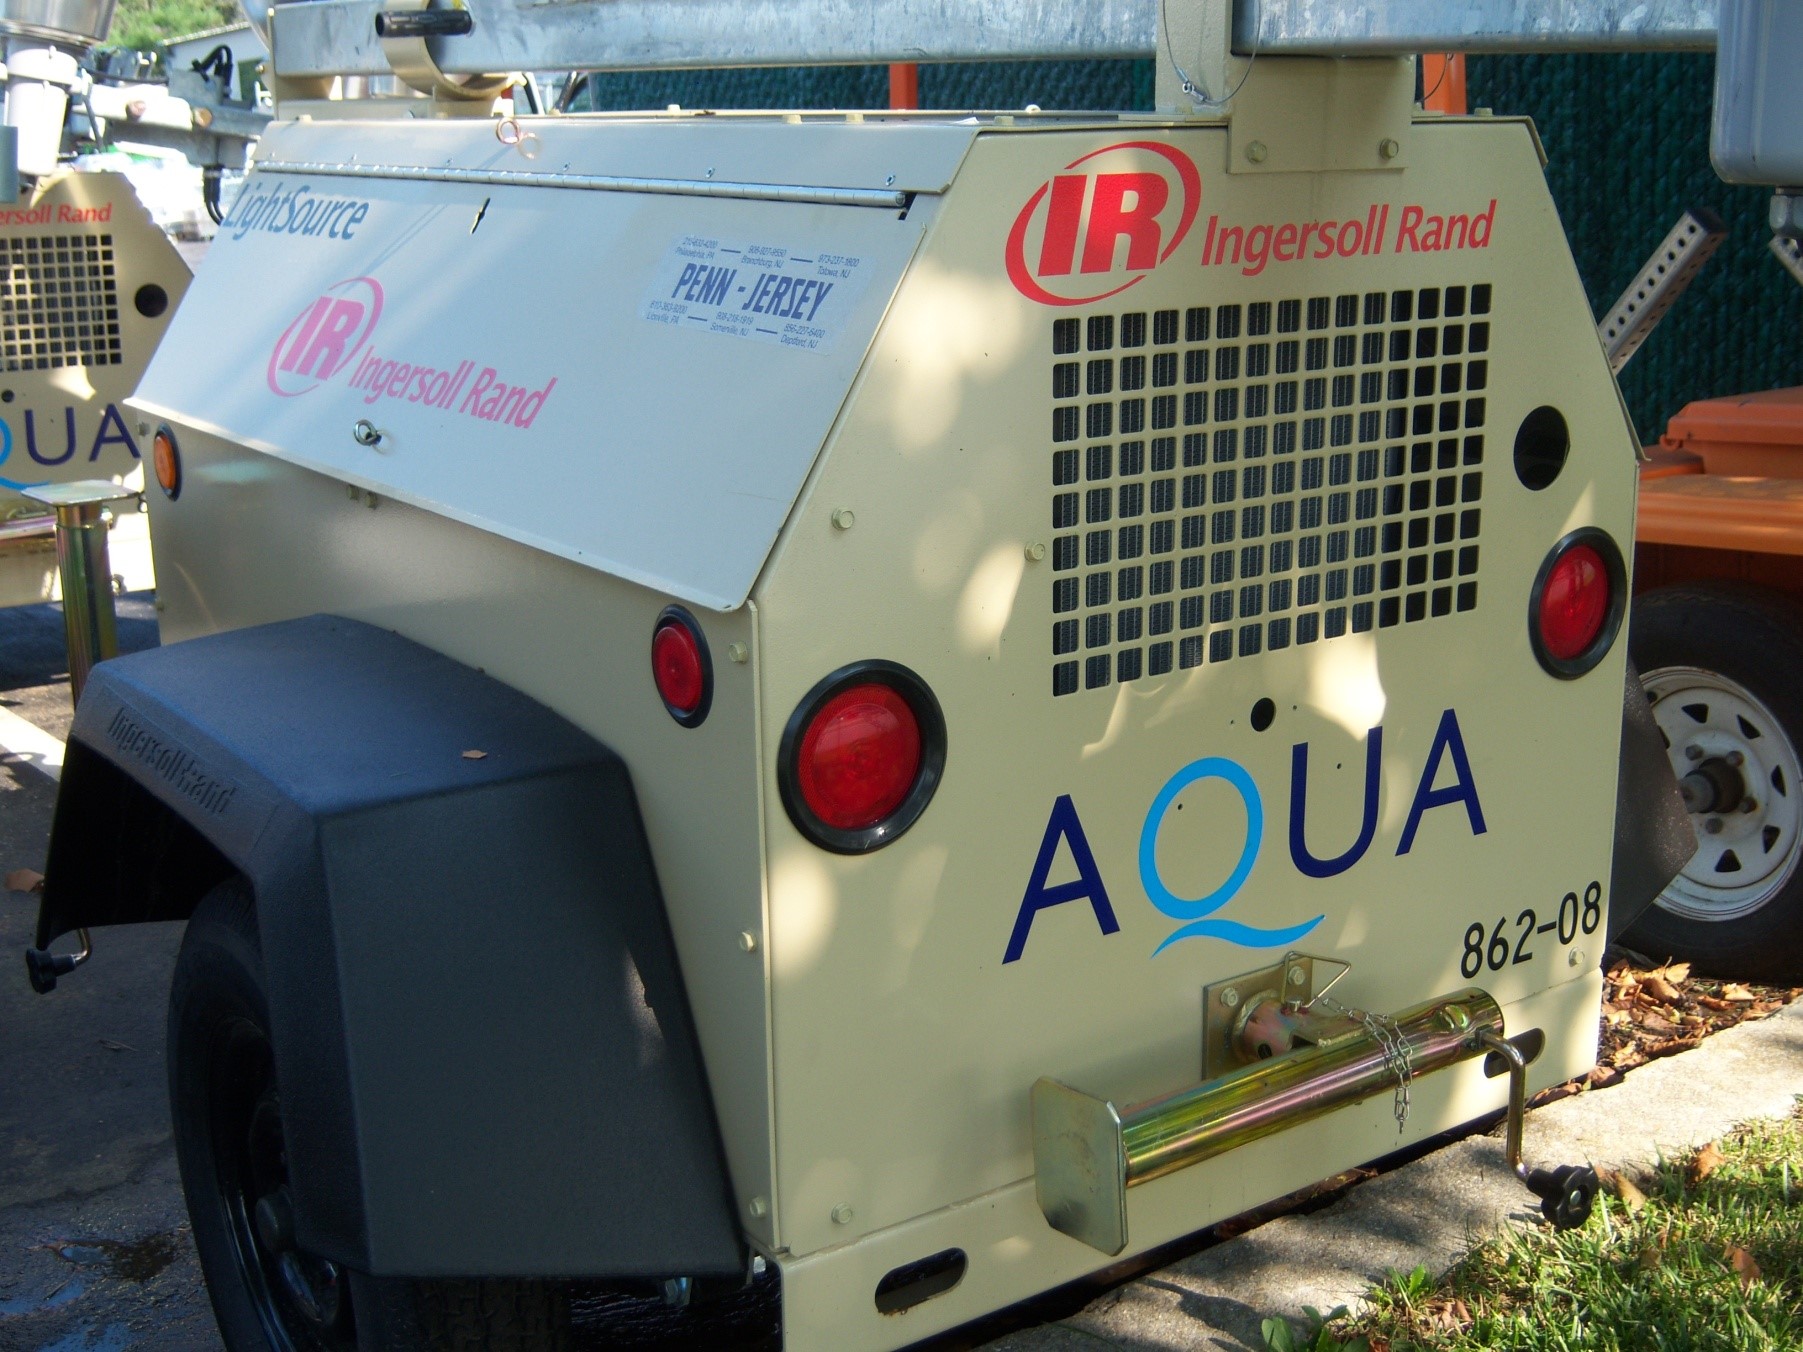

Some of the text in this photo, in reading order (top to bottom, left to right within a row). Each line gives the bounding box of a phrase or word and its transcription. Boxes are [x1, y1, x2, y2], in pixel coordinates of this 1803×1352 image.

[57, 201, 113, 224] Rand
[220, 181, 370, 241] LightSource
[1037, 172, 1169, 277] IR
[1201, 198, 1498, 277] Ingersoll Rand
[671, 262, 737, 306] PENN
[742, 273, 834, 322] JERSEY
[840, 269, 851, 279] NJ
[279, 295, 366, 381] IR
[739, 327, 750, 337] NJ
[807, 339, 819, 349] NJ
[348, 345, 559, 430] Ingersoll Rand
[0, 403, 142, 492] UA
[1002, 708, 1488, 959] AQUA
[1460, 881, 1602, 980] 862-08
